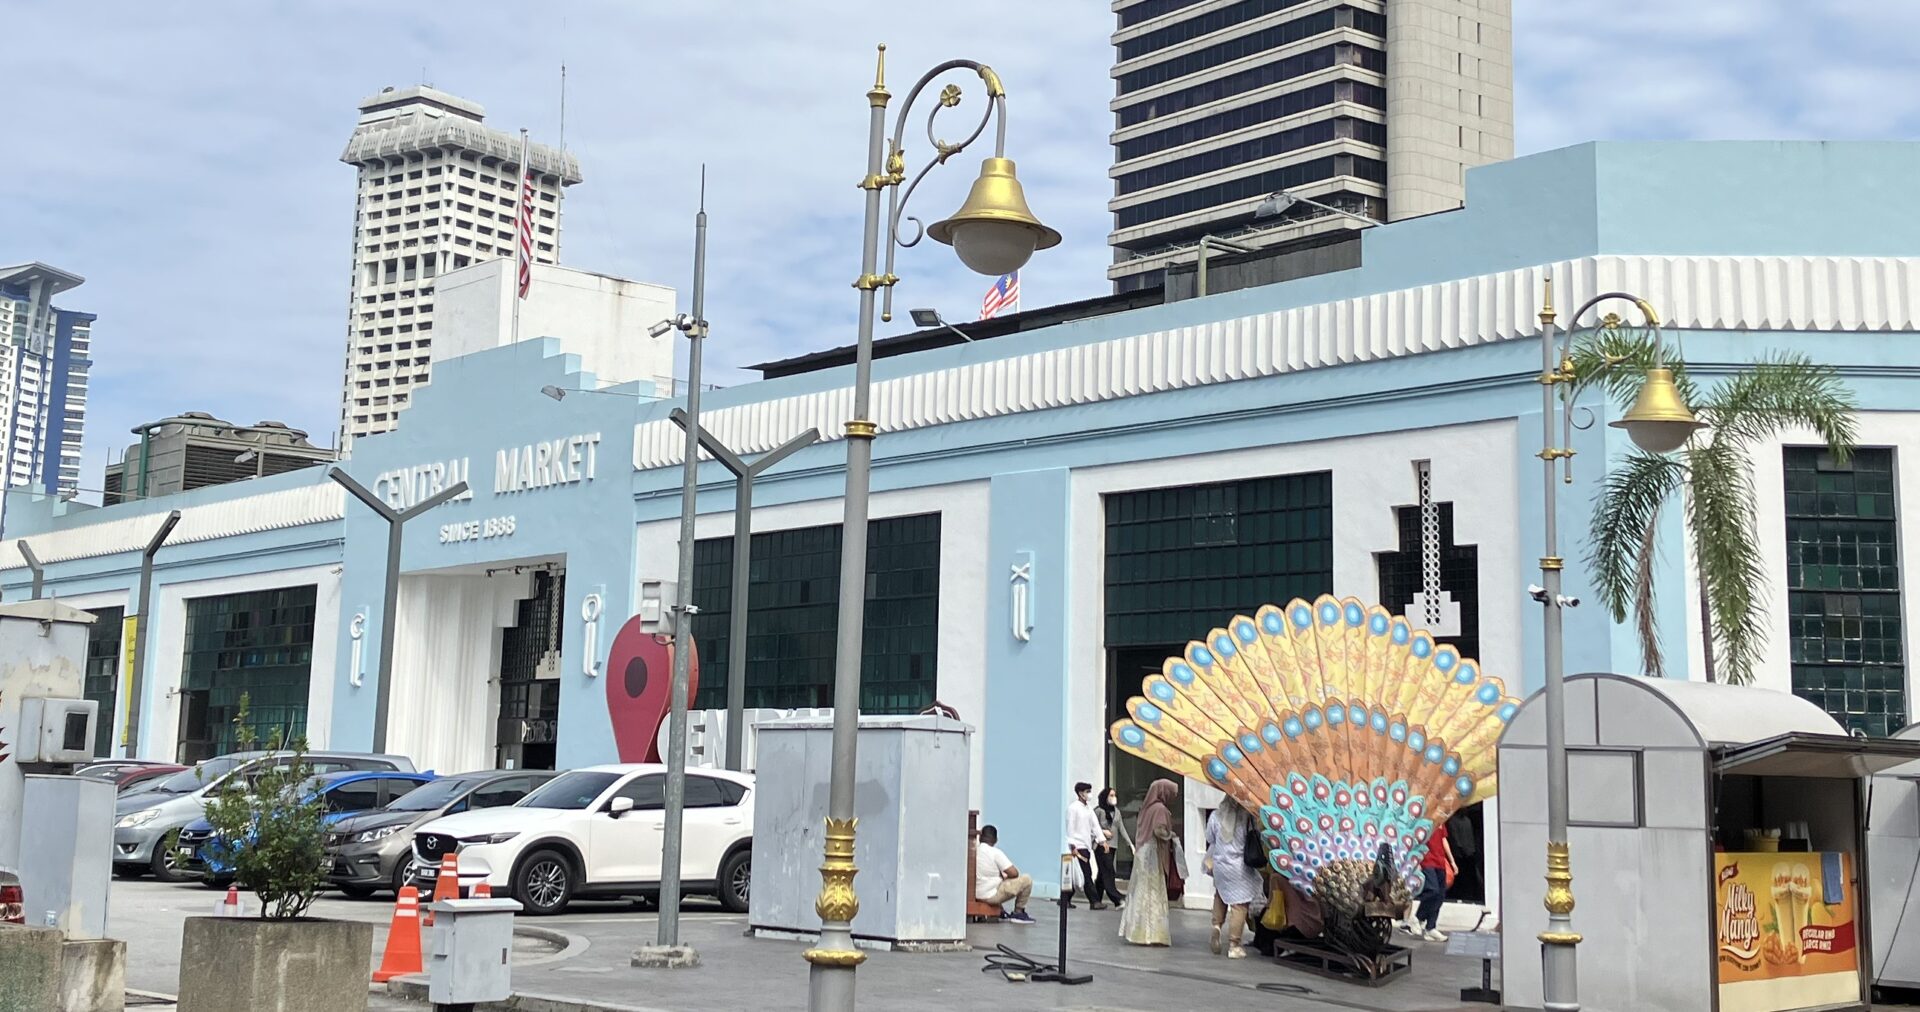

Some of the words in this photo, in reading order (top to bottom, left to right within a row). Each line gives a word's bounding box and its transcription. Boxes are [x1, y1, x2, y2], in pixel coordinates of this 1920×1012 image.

[372, 457, 473, 510] CENTRAL
[494, 432, 600, 493] MARKET
[439, 521, 479, 543] SINCE
[482, 515, 516, 539] 1888
[1725, 883, 1755, 919] Milky
[1719, 908, 1760, 951] Mango
